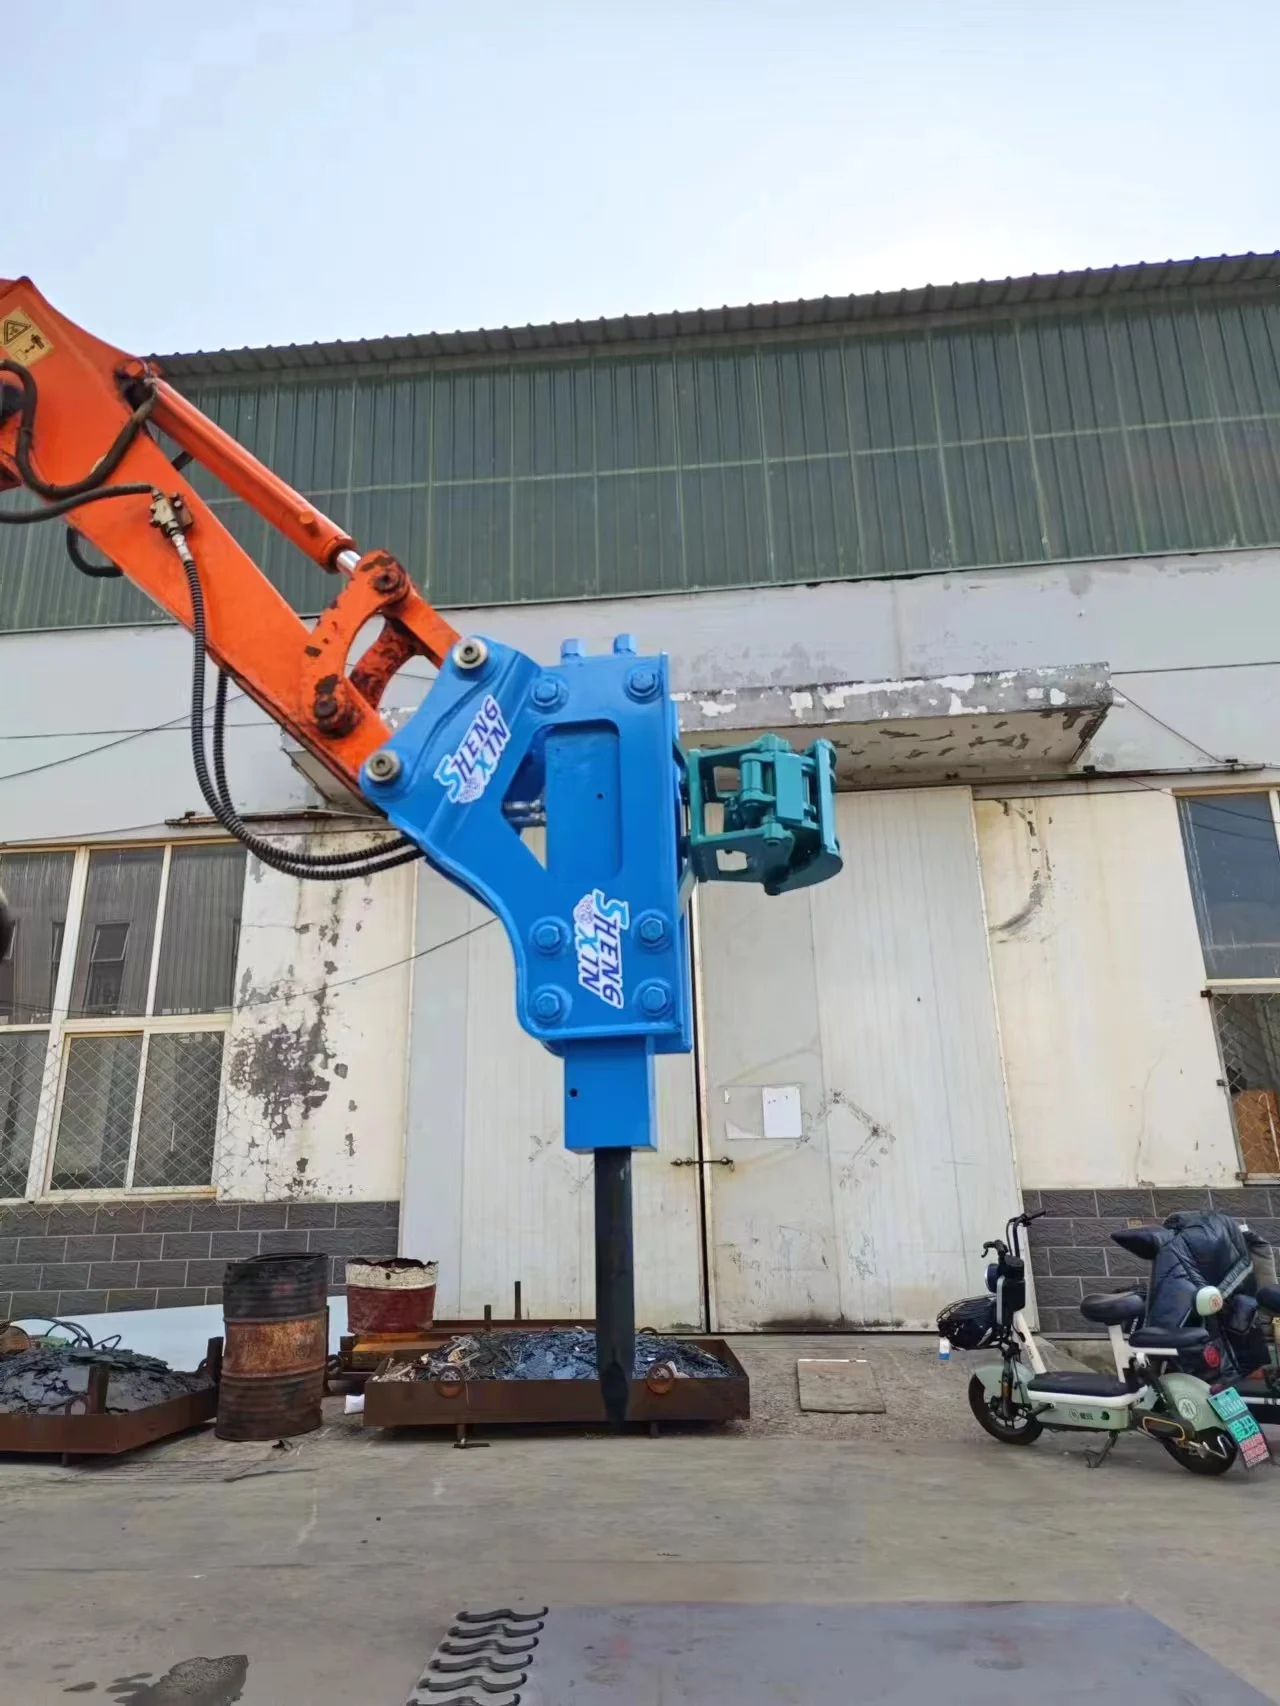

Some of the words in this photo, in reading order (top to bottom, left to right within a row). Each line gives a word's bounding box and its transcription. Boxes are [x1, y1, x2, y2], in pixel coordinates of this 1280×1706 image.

[438, 697, 498, 800] SHENG
[474, 717, 509, 781] XIN
[575, 924, 601, 993] XIN
[587, 889, 629, 1007] SHENG
